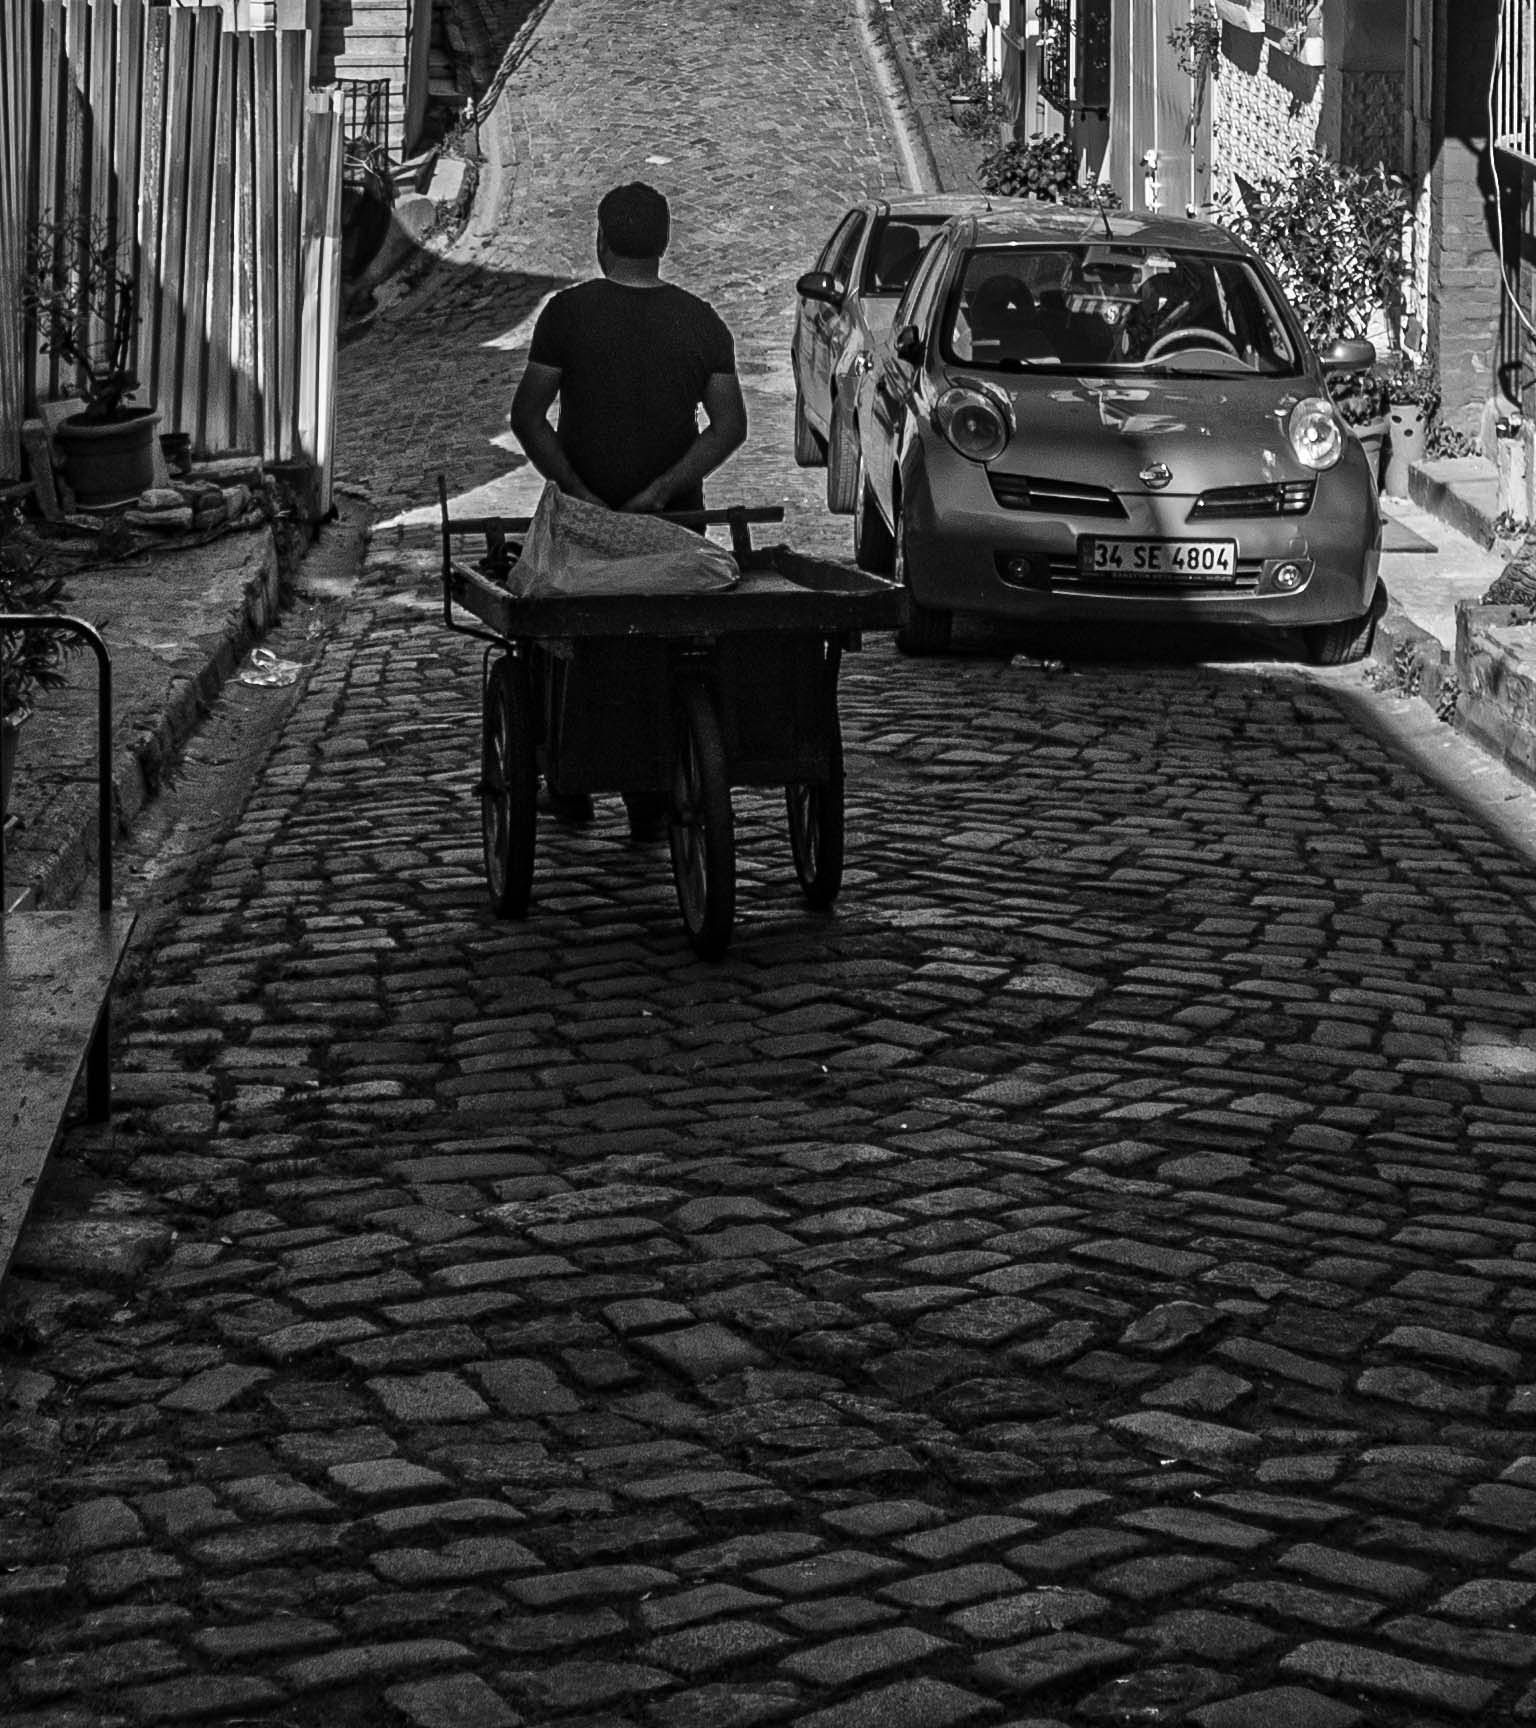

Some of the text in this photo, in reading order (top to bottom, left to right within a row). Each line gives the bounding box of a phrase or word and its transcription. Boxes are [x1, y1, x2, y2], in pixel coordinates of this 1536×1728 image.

[1095, 543, 1122, 569] 34
[1133, 545, 1162, 570] SE
[1172, 547, 1229, 570] 4804
